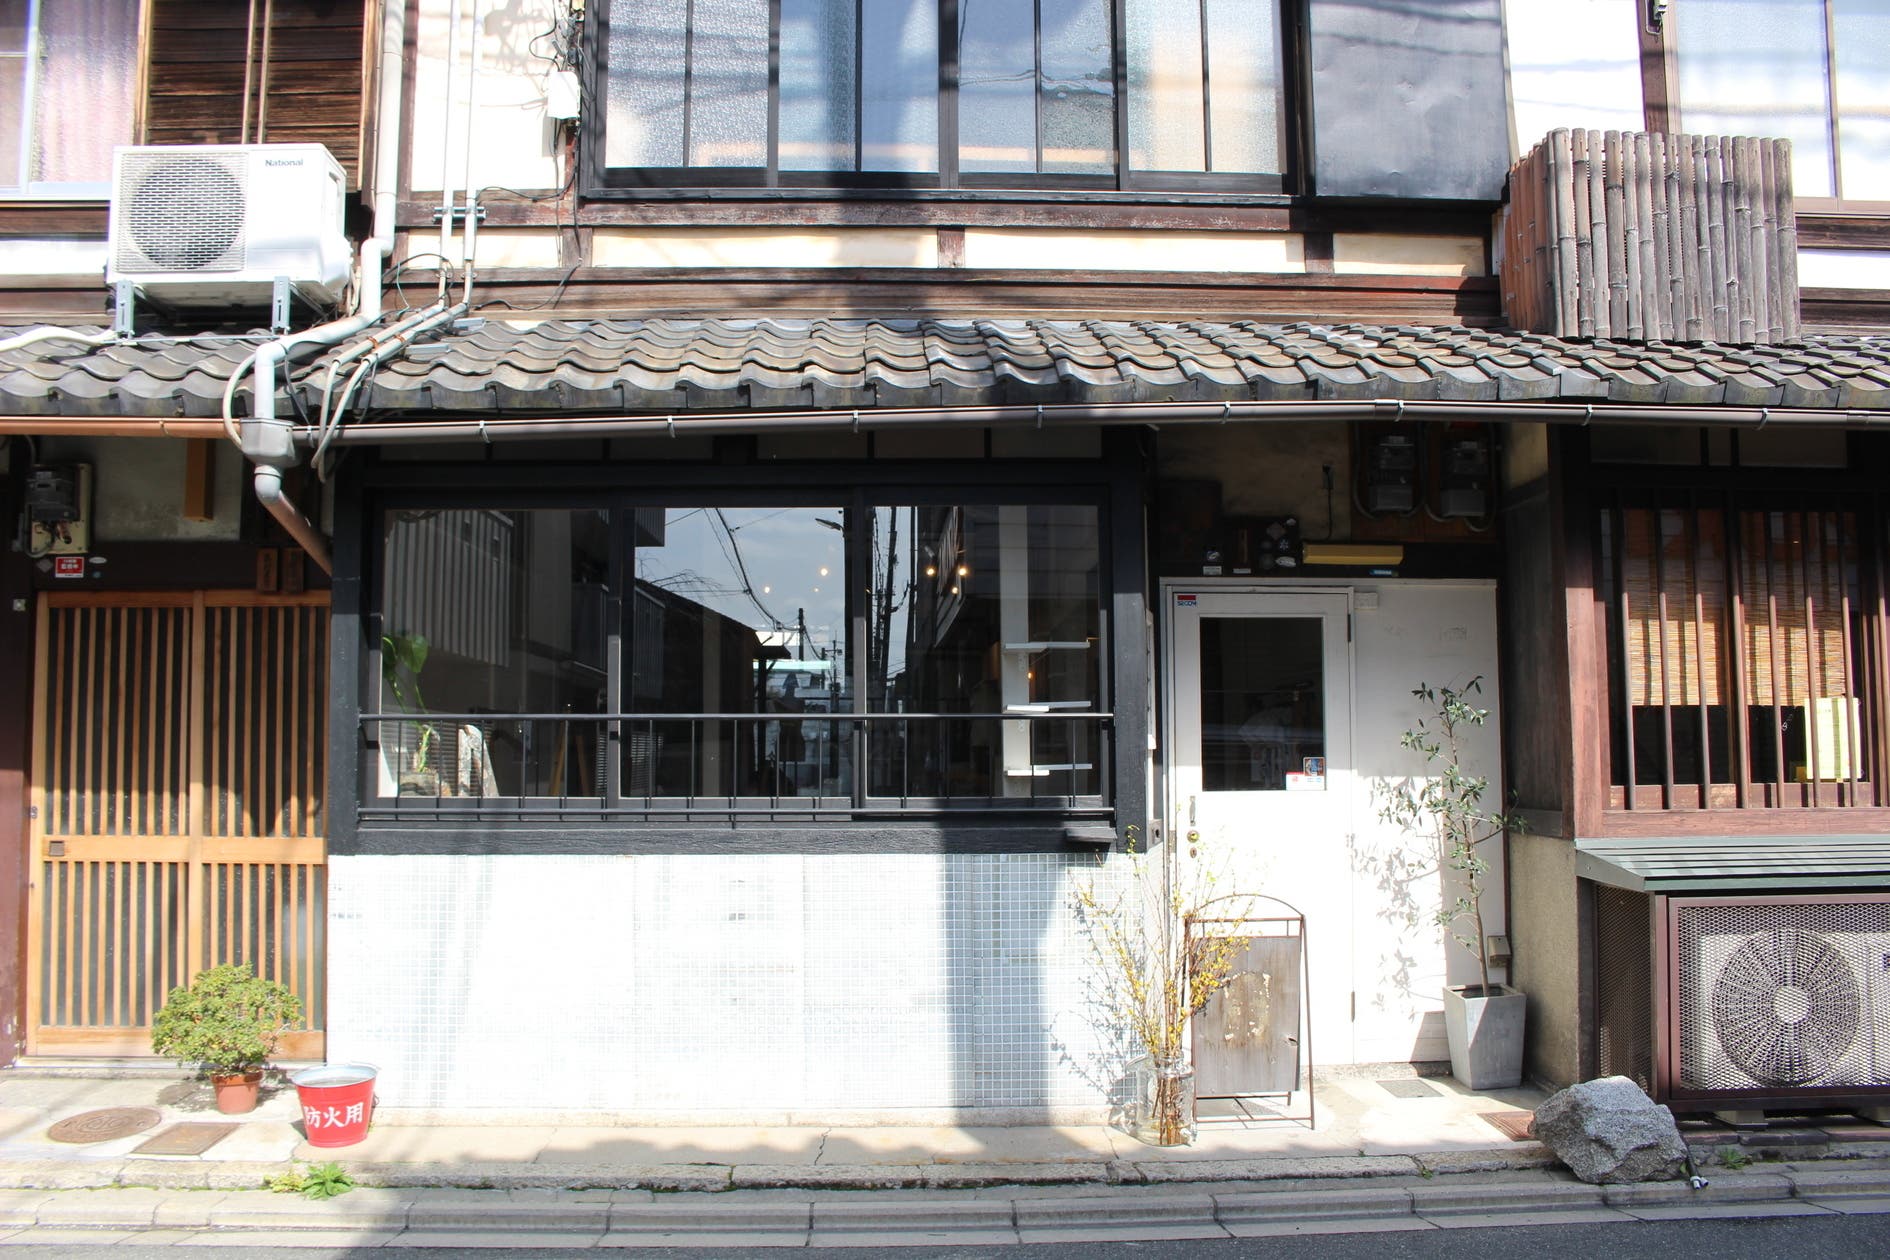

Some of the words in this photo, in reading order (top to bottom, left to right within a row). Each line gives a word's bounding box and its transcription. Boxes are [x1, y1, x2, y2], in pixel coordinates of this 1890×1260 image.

[265, 158, 304, 167] National
[303, 1102, 364, 1128] 防火用
